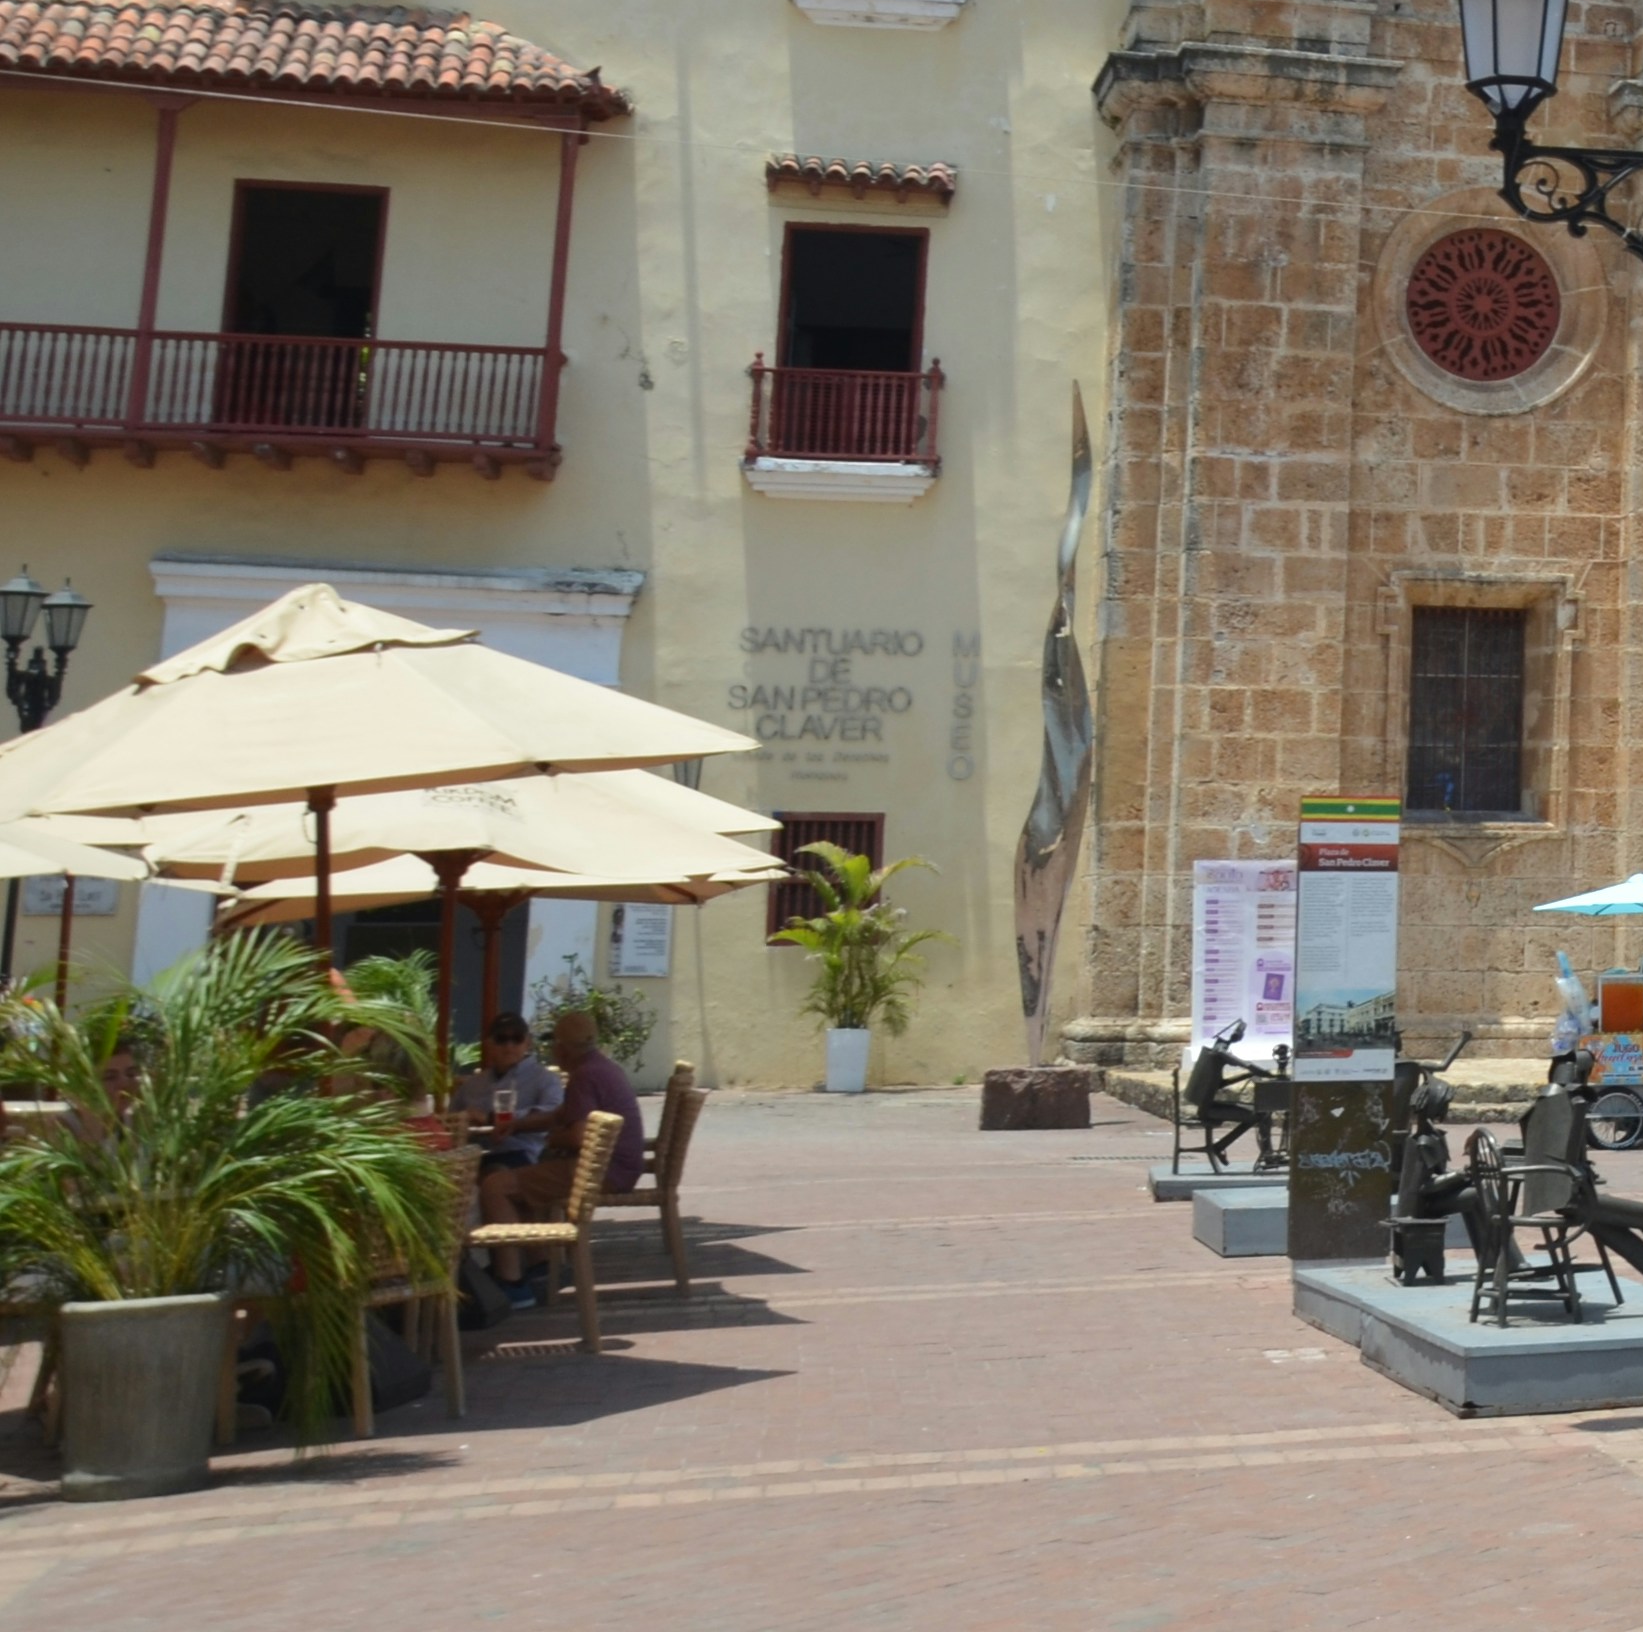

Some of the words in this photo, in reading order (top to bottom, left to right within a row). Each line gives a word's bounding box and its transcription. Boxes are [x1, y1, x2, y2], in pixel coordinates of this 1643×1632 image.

[740, 627, 924, 656] SANTUARIO
[809, 657, 851, 684] DE
[728, 685, 795, 710] SAN
[802, 687, 912, 713] PEDRO
[948, 630, 980, 781] MUSEO
[756, 715, 883, 741] CLAVER
[1319, 858, 1336, 866] San
[1337, 858, 1361, 866] Pedro
[1362, 858, 1390, 866] Claver
[1613, 1043, 1640, 1052] JUGO
